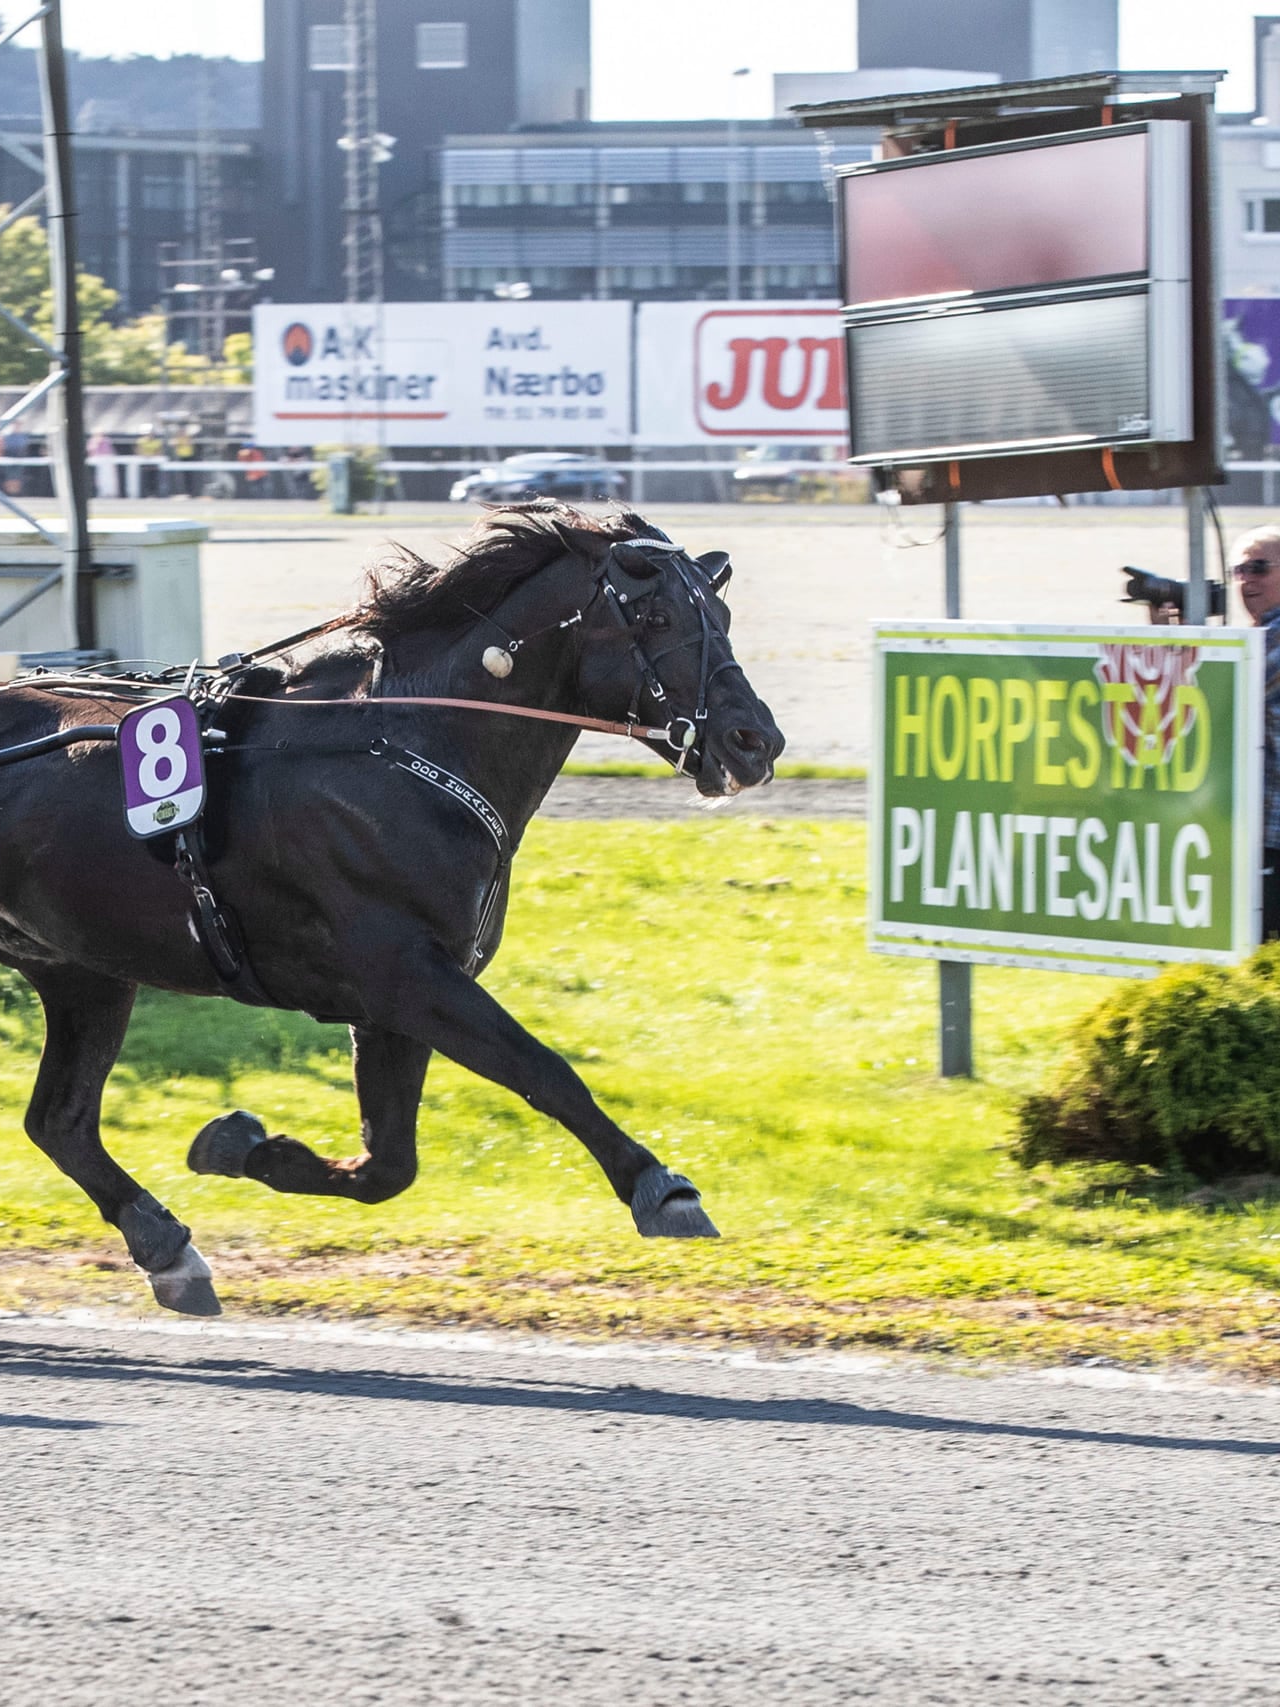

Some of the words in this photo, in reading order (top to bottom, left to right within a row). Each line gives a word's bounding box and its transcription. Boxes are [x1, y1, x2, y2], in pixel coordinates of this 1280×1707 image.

[285, 366, 436, 401] maskiner
[484, 366, 605, 396] Nærbø
[136, 707, 187, 798] 8
[893, 675, 1211, 792] HORPESTAD
[411, 760, 439, 779] ODD
[445, 779, 503, 837] HERAKLES
[891, 807, 1211, 928] PLANTESALG
